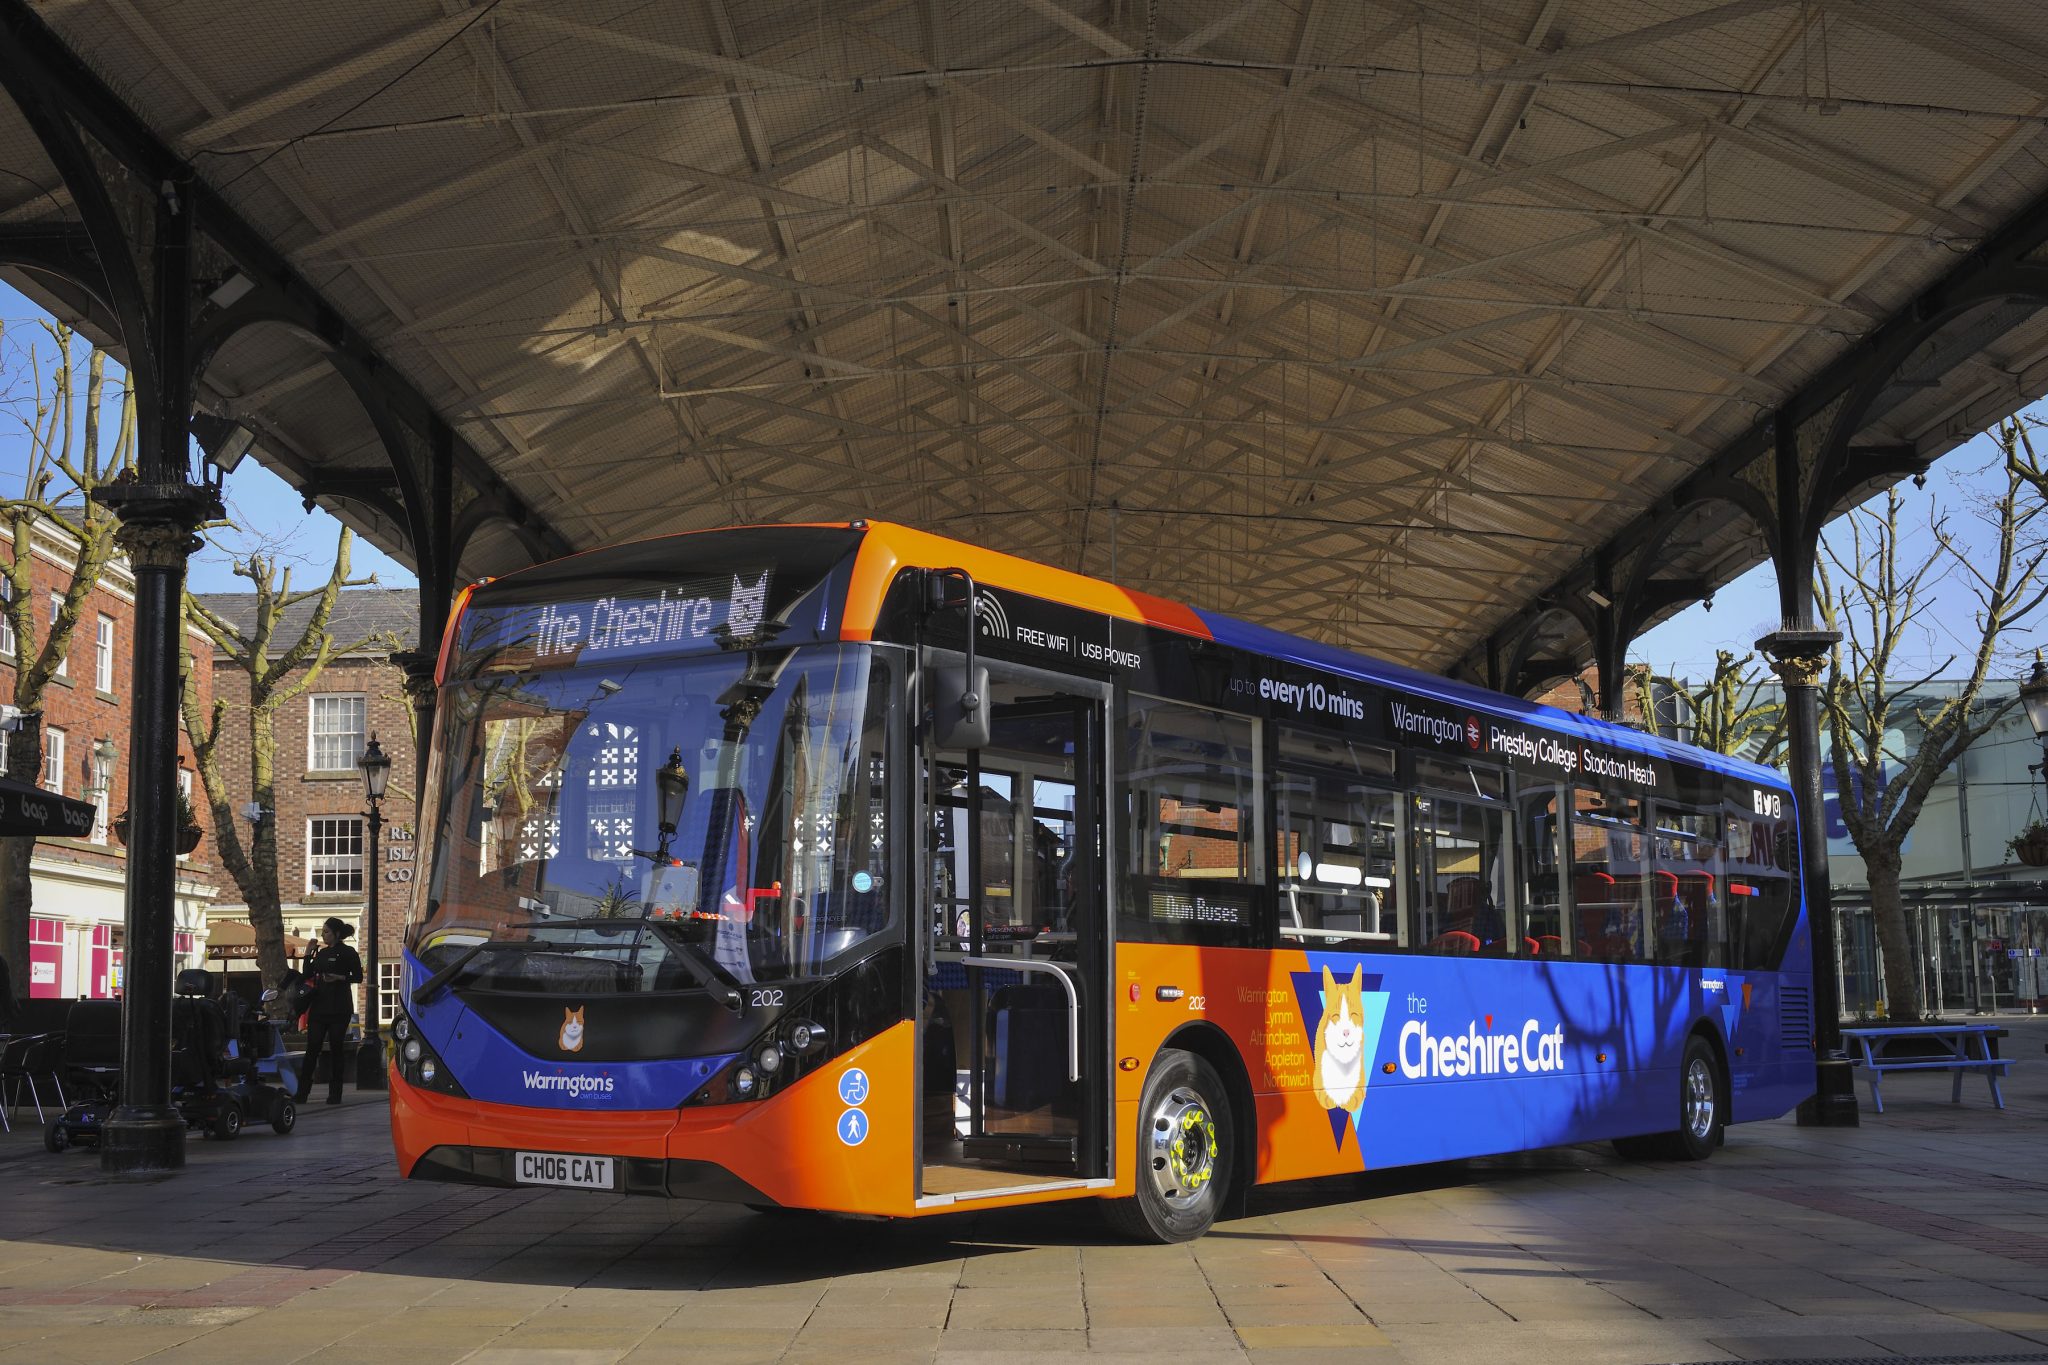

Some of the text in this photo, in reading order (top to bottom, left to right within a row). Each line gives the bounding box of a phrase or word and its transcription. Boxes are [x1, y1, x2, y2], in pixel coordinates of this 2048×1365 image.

[537, 588, 712, 657] the Cheshire
[1016, 627, 1141, 670] FREE WIFI USB POWER
[1230, 677, 1364, 720] up to every 10 mins
[1391, 702, 1656, 787] Warrington Priestley College Stockton Heath
[388, 868, 414, 882] CO
[1197, 898, 1238, 922] Buses
[751, 989, 784, 1007] 202
[1188, 996, 1205, 1010] 202
[1237, 986, 1288, 1007] Warrington
[1407, 992, 1427, 1014] the
[1265, 1008, 1293, 1028] Lymm
[1250, 1028, 1300, 1047] Altrincham
[1399, 1016, 1564, 1079] Cheshire Cat
[1264, 1051, 1305, 1070] Appleton
[1263, 1070, 1310, 1088] Northwich
[523, 1156, 605, 1183] CH06 CAT
